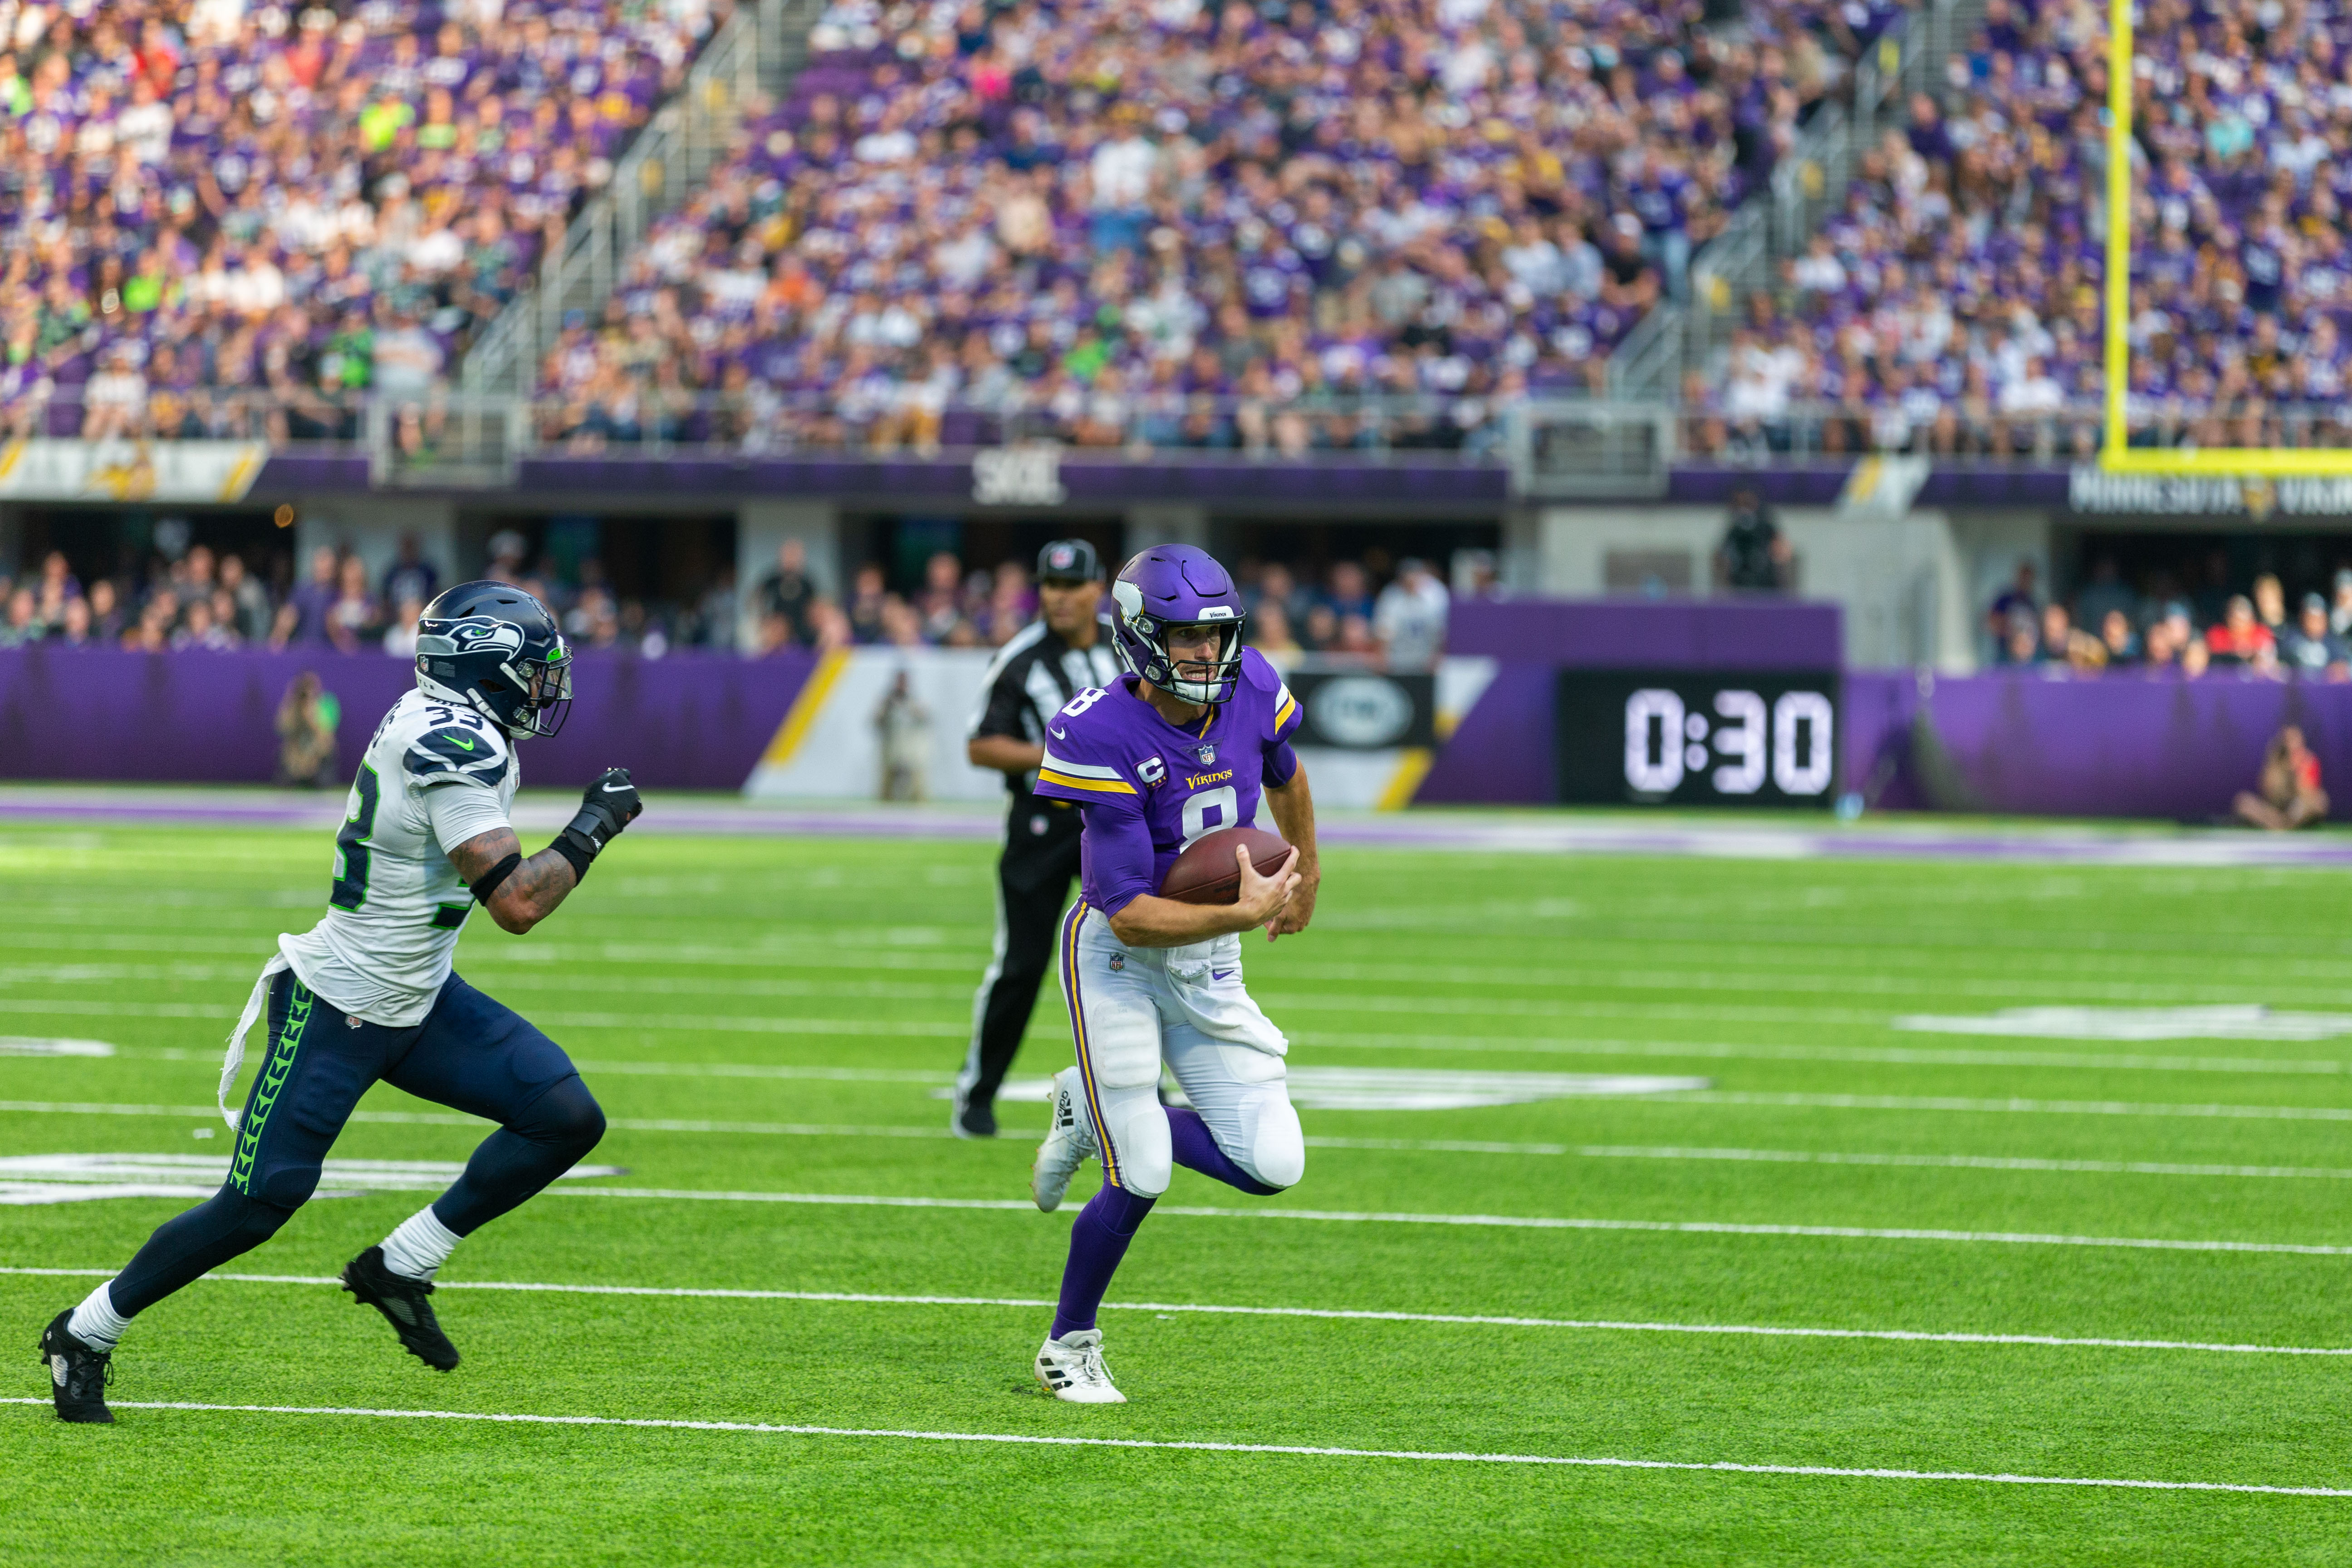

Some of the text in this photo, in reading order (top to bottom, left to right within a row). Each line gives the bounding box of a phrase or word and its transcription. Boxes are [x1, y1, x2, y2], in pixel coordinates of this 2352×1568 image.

[1062, 687, 1109, 717] 8
[426, 706, 483, 730] 33
[1624, 688, 1833, 795] 0:30
[1137, 757, 1164, 783] C
[1202, 754, 1214, 762] NFL
[1112, 961, 1122, 970] NFL
